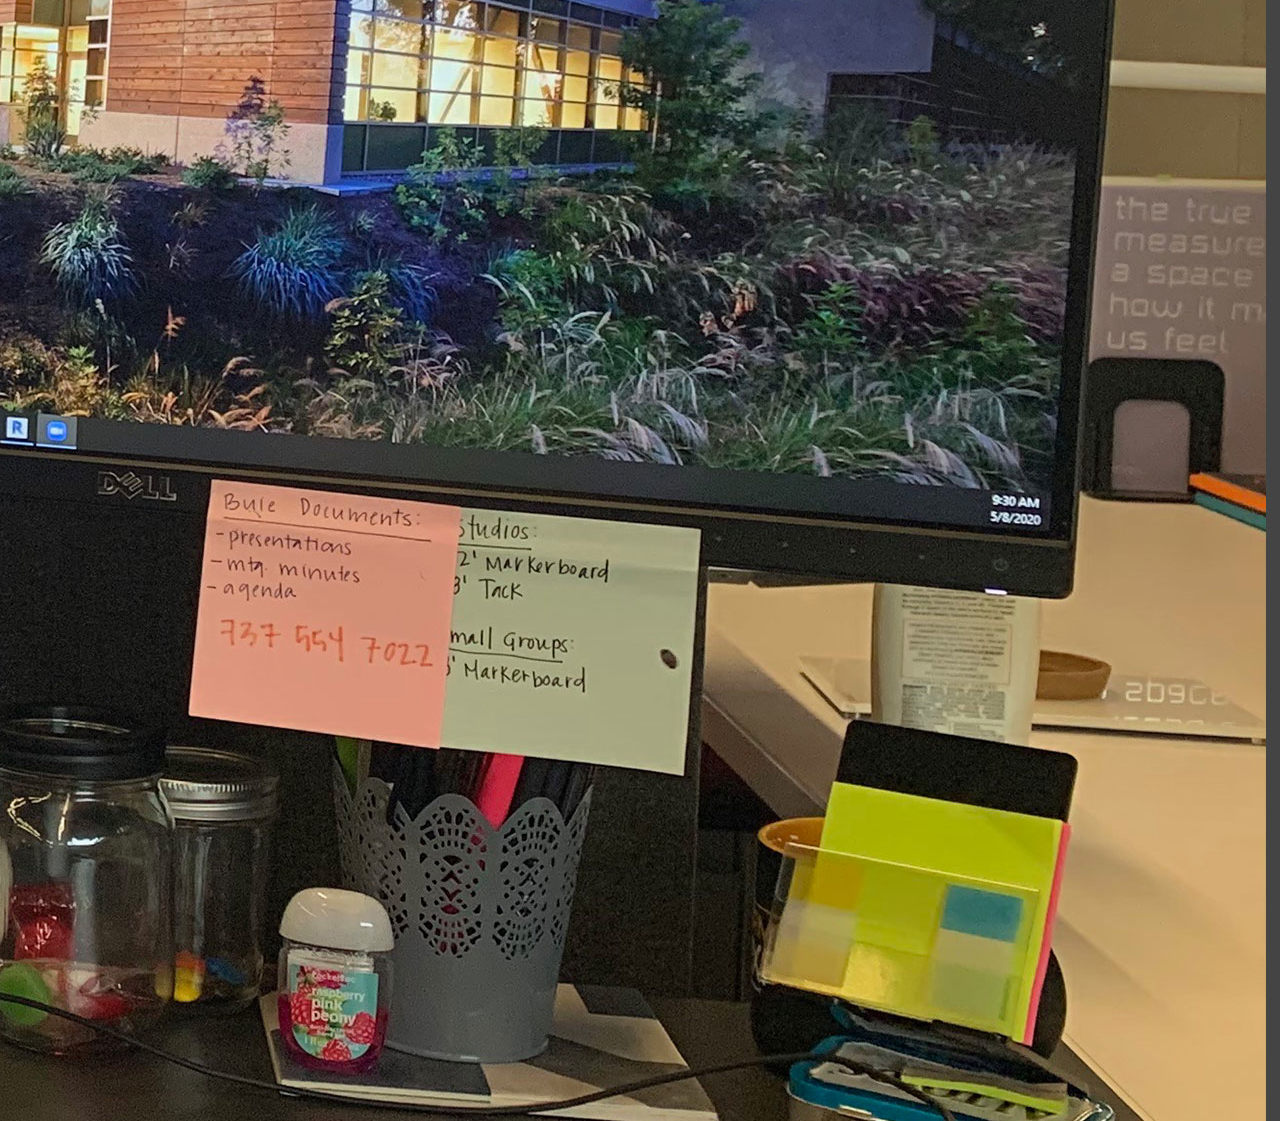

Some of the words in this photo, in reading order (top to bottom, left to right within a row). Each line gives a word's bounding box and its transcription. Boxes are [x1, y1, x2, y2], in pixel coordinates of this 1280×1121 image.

[1116, 195, 1169, 221] the
[1186, 198, 1251, 224] true
[1114, 232, 1265, 256] measure
[1111, 263, 1129, 282] a
[1148, 264, 1253, 288] space
[1109, 293, 1182, 318] how
[1198, 297, 1214, 318] it
[1231, 301, 1266, 320] m
[1107, 331, 1147, 351] us
[1165, 327, 1228, 353] feel
[97, 470, 177, 501] DELL
[300, 498, 420, 527] Documents:
[992, 494, 1016, 506] 9:30
[1018, 497, 1040, 508] AM
[990, 511, 1041, 526] 5/8/2020
[279, 560, 361, 584] minutes
[486, 556, 609, 583] Markerboard
[223, 583, 296, 601] agenda
[479, 578, 523, 600] Tack
[220, 619, 281, 647] 737
[295, 624, 344, 662] 554
[360, 636, 433, 666] 7022
[450, 626, 492, 649] mall
[503, 632, 574, 658] Groups:
[464, 659, 585, 693] Markerboard
[311, 998, 343, 1011] pink
[312, 988, 366, 1002] raspberry
[311, 1010, 357, 1026] peony
